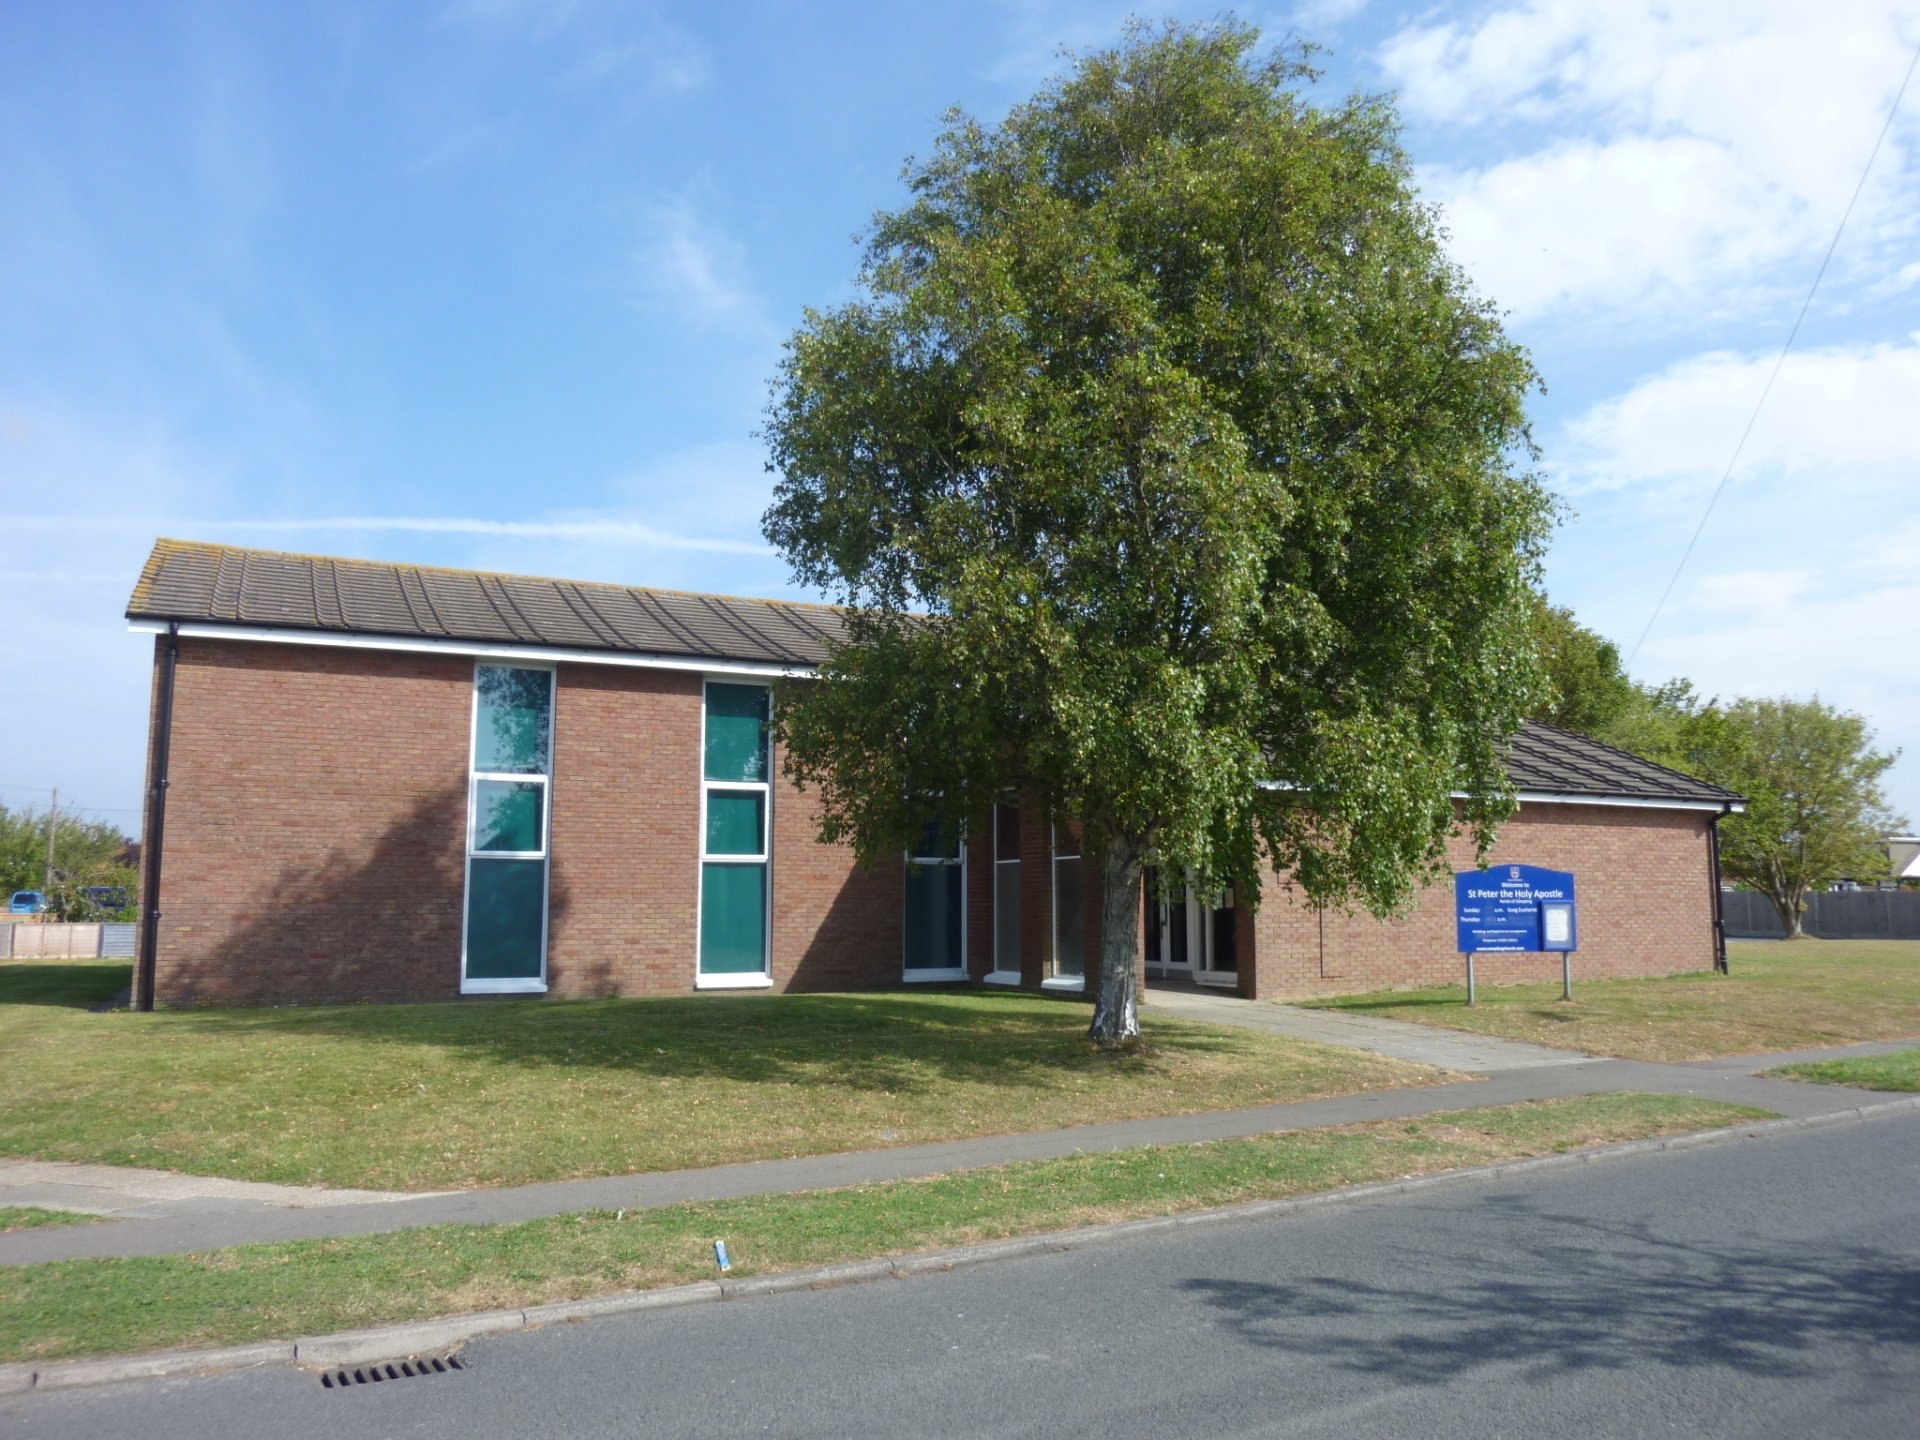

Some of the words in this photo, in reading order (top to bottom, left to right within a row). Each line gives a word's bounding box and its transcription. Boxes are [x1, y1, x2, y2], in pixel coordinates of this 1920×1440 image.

[1468, 889, 1476, 898] St
[1477, 889, 1498, 898] Peter
[1500, 889, 1513, 898] the
[1515, 889, 1532, 899] Holy
[1534, 890, 1562, 899] Apostle
